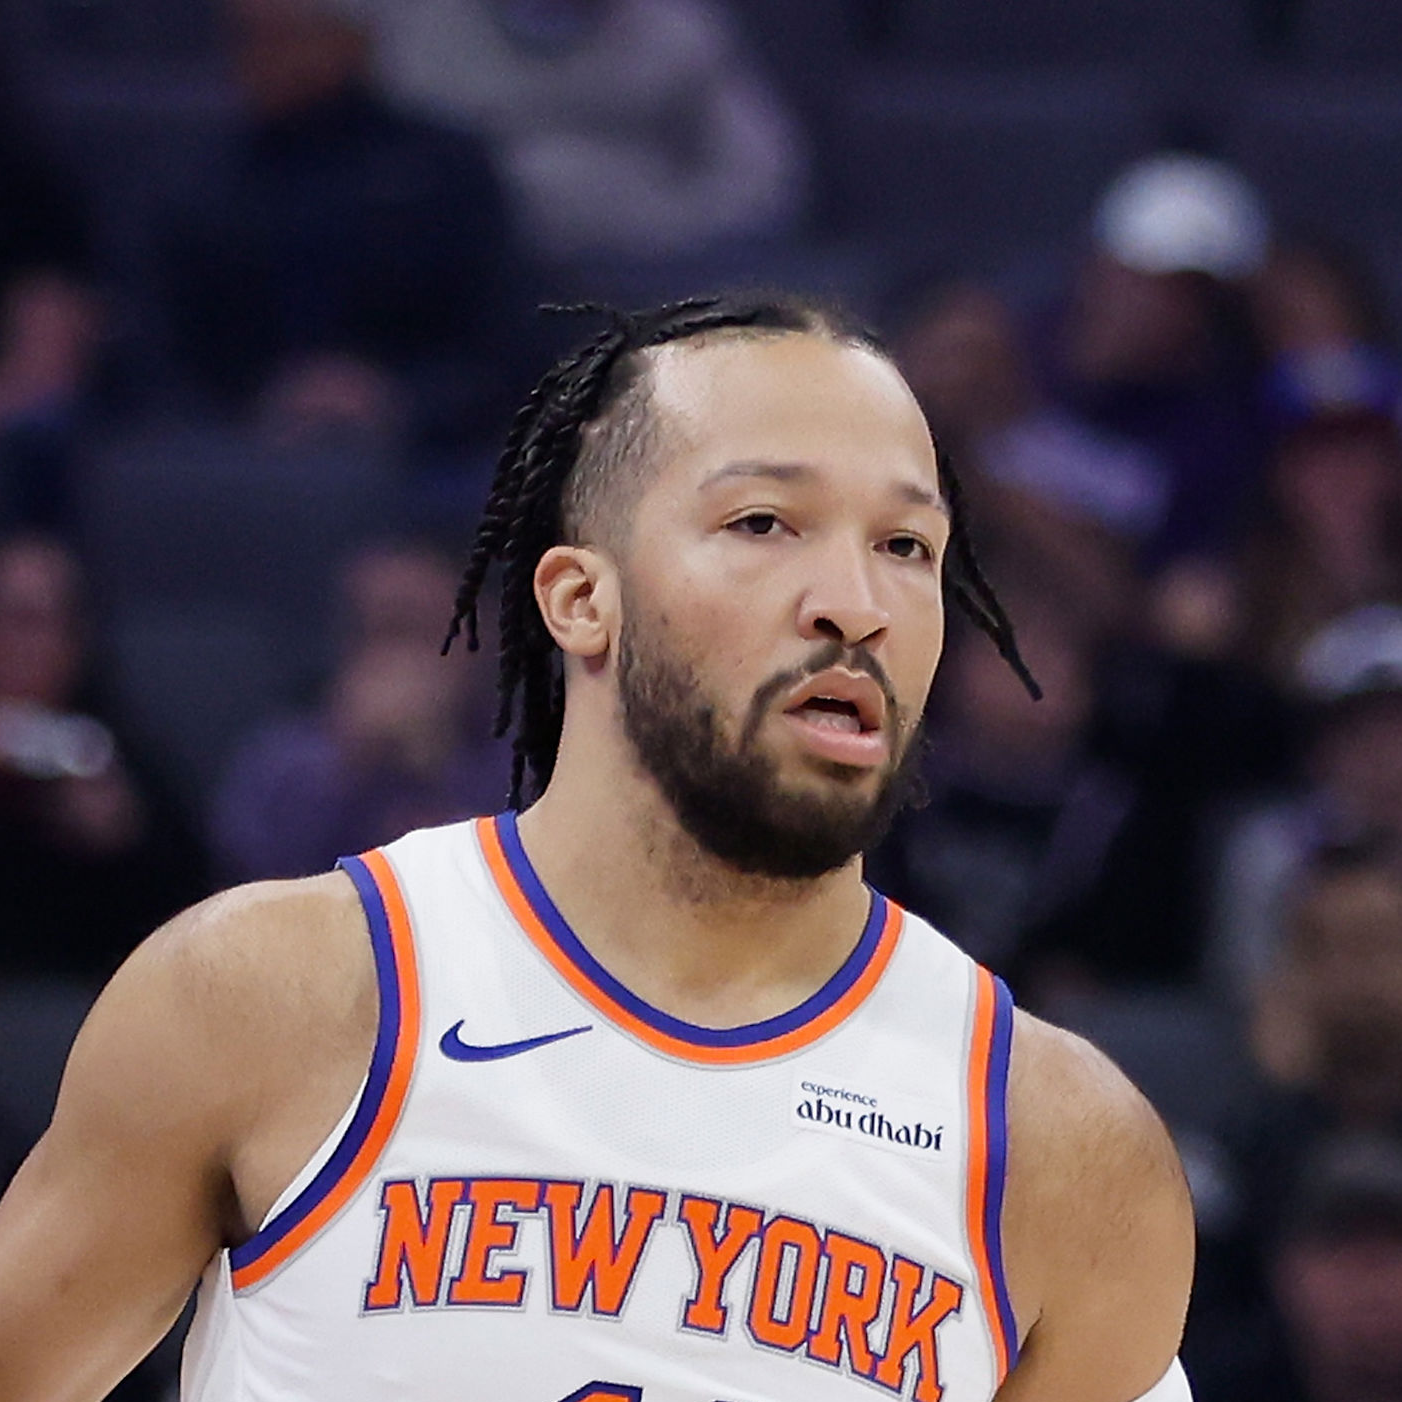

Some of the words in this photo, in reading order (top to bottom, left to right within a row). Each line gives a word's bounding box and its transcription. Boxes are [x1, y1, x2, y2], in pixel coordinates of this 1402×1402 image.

[801, 1080, 877, 1107] experience
[796, 1099, 851, 1129] abu
[858, 1112, 944, 1151] dhabi
[360, 1176, 667, 1317] NEW
